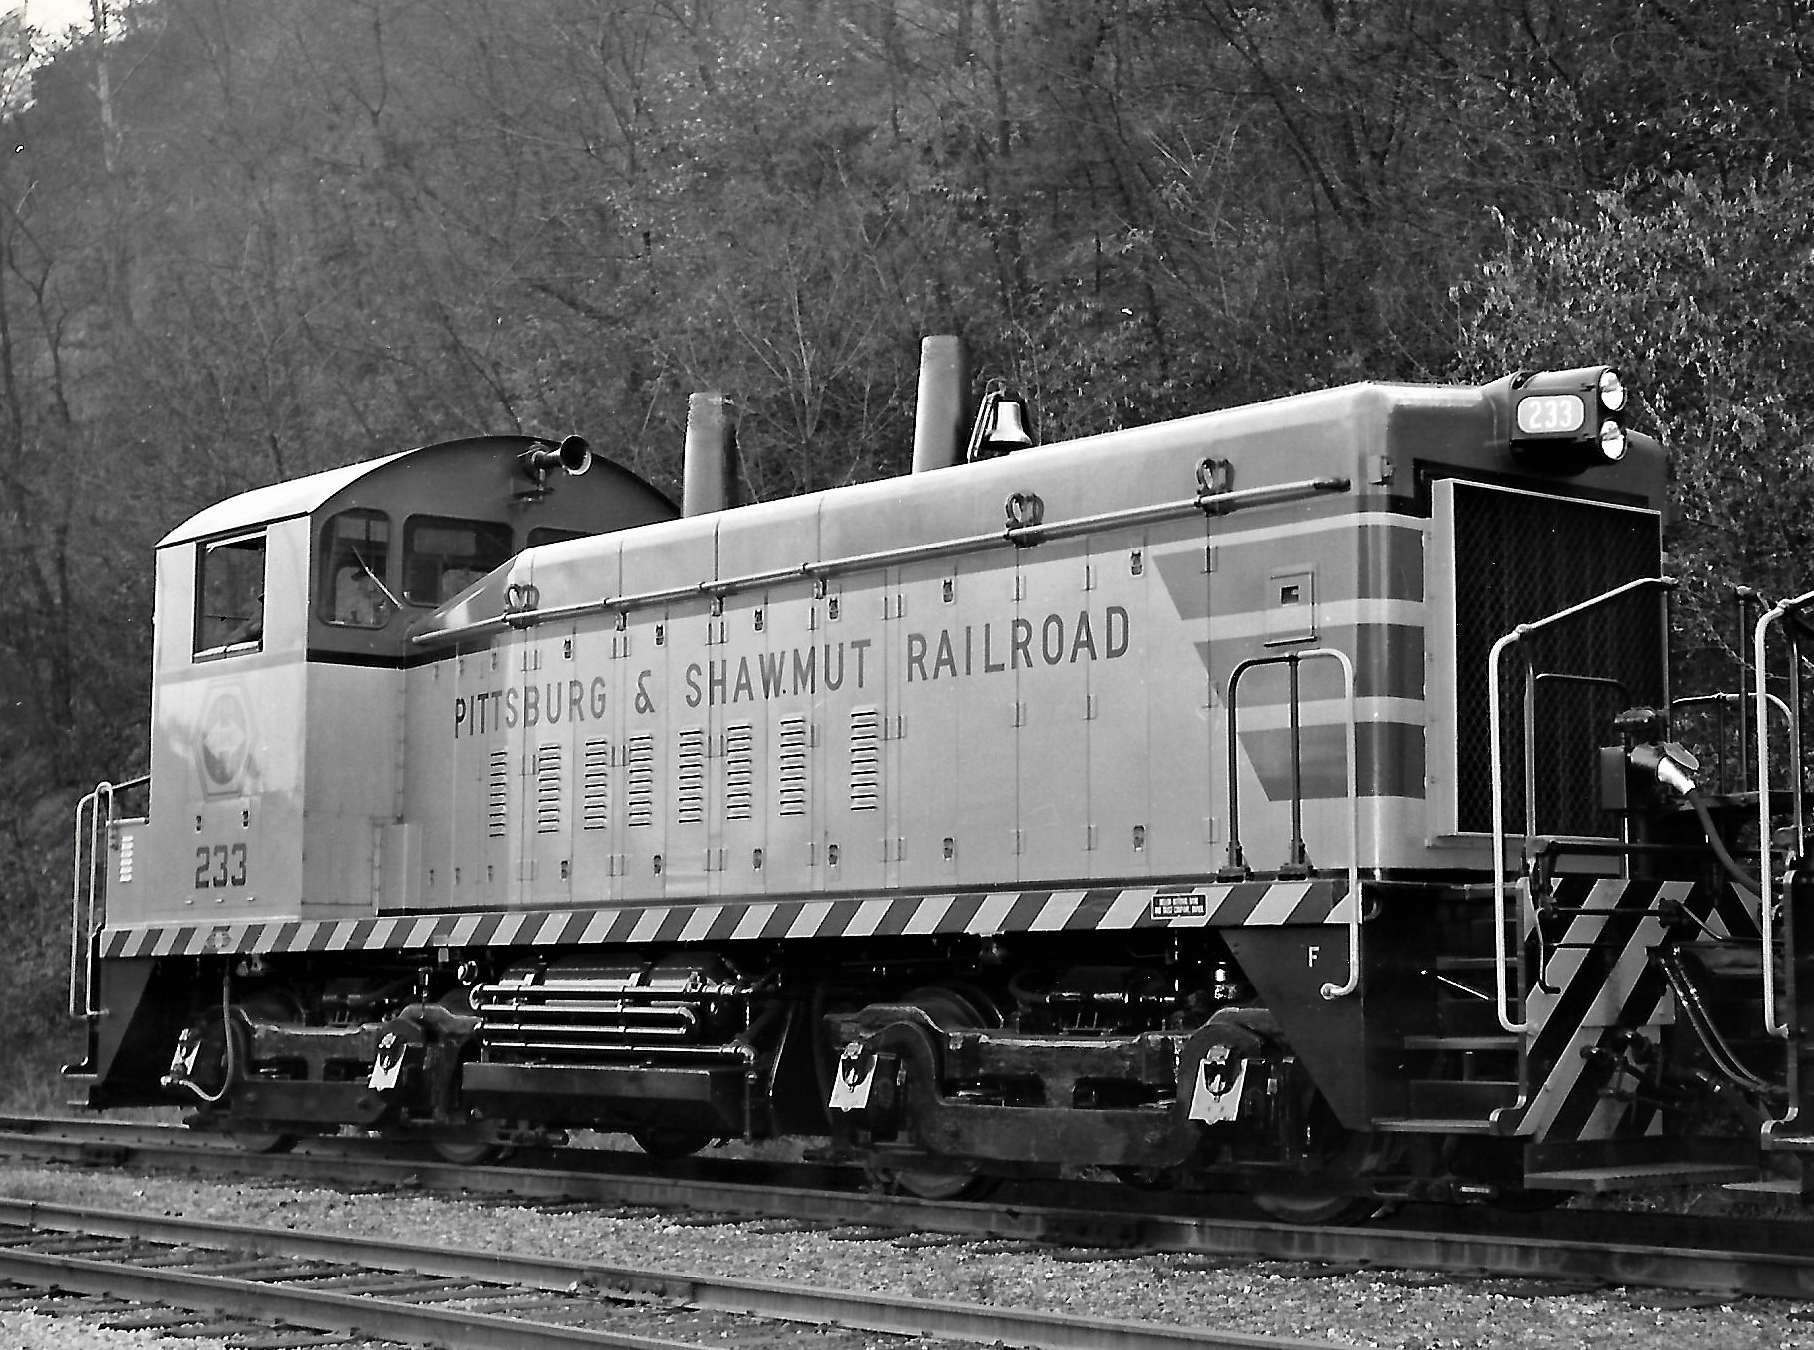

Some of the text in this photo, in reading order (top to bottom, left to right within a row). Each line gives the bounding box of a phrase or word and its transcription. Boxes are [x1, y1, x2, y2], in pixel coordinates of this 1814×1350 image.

[1529, 400, 1573, 428] 233
[454, 676, 607, 739] PITTSBURG
[635, 670, 656, 714] &
[907, 605, 1130, 682] RAILROAD
[195, 842, 247, 889] 233
[1308, 946, 1320, 967] F
